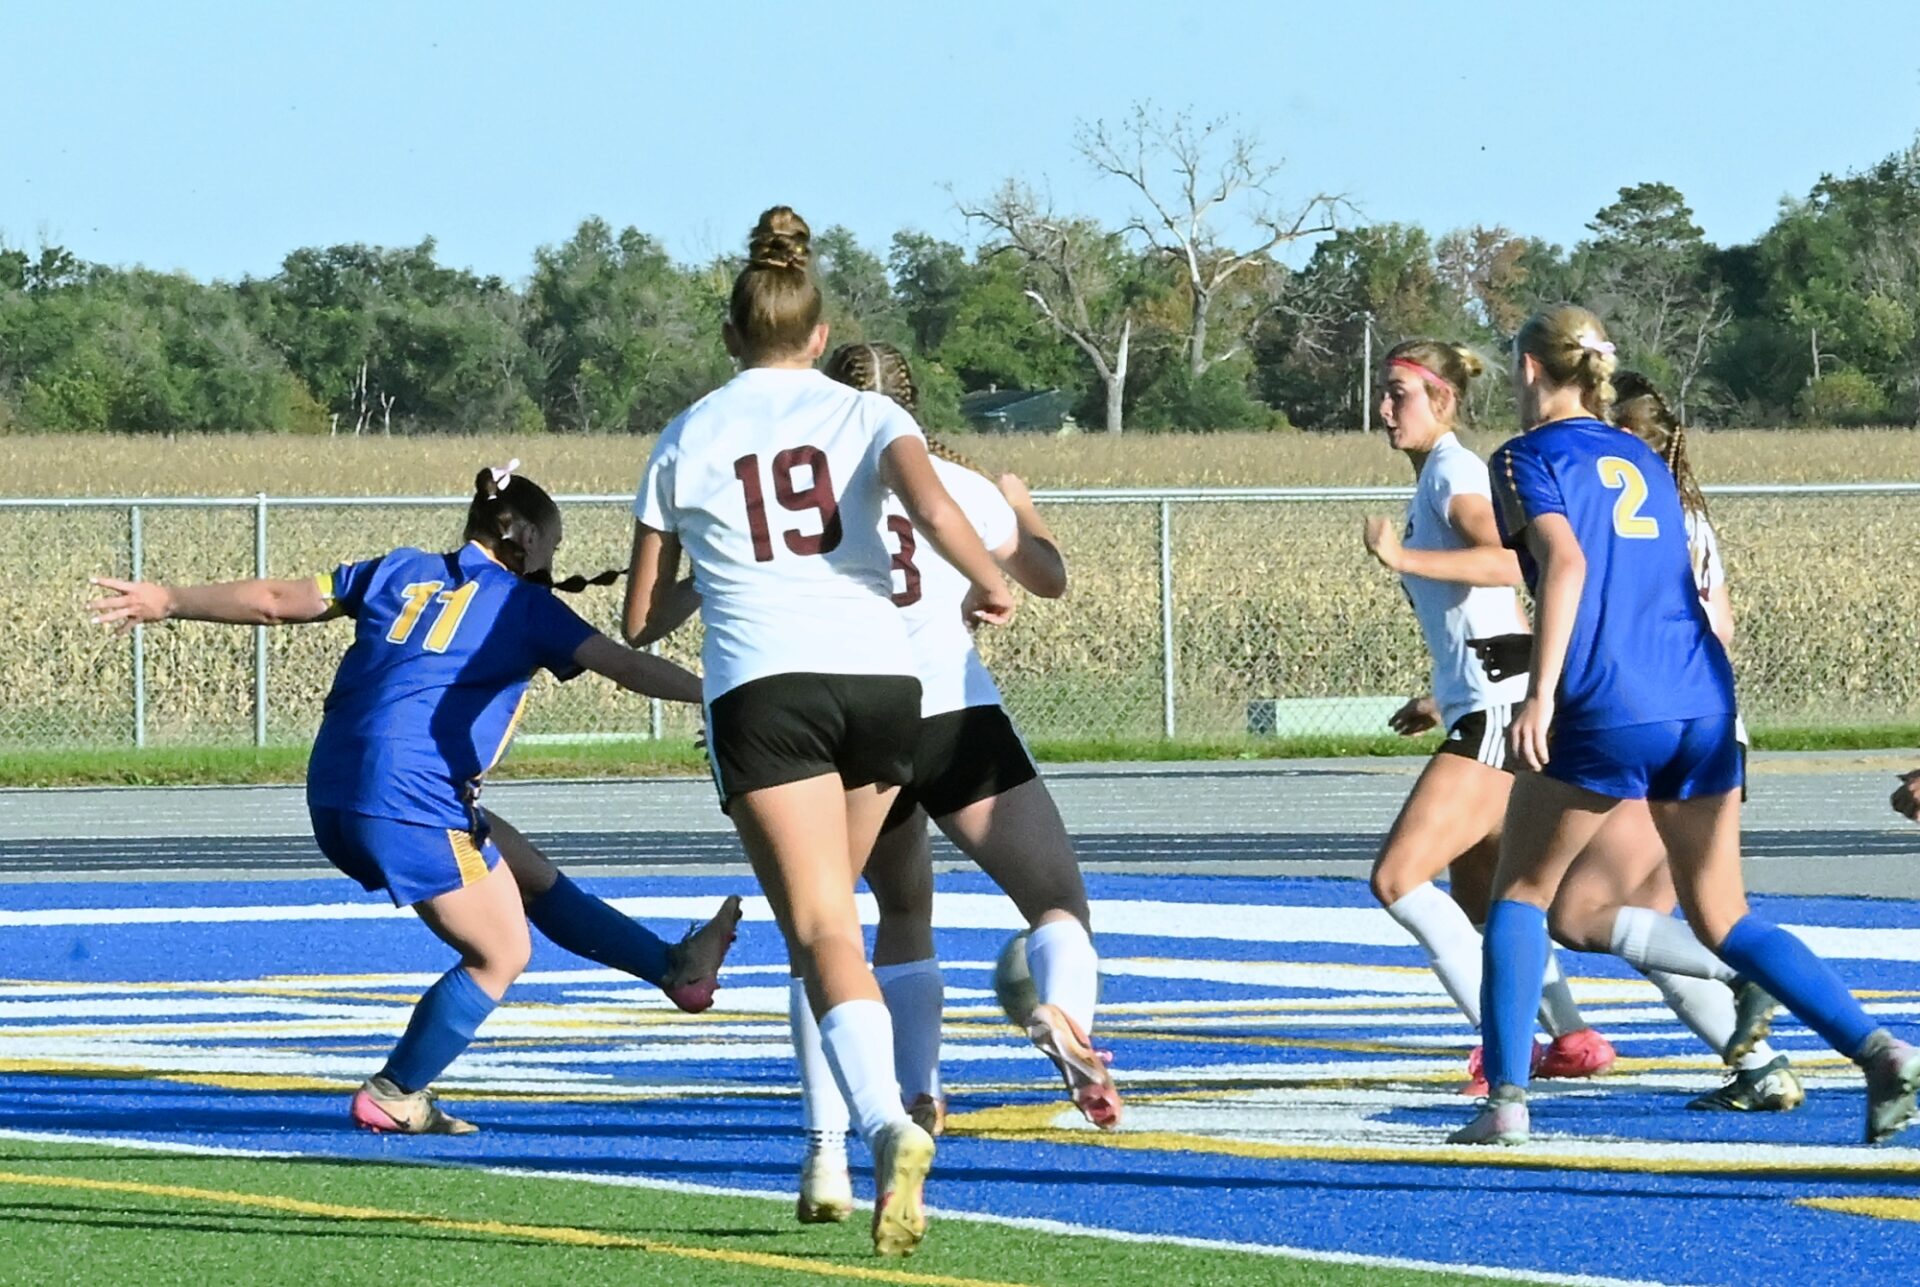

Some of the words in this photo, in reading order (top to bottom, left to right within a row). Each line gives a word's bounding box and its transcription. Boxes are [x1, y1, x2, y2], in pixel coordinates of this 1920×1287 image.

[734, 445, 843, 562] 19
[1597, 456, 1659, 538] 2
[386, 580, 479, 653] 11
